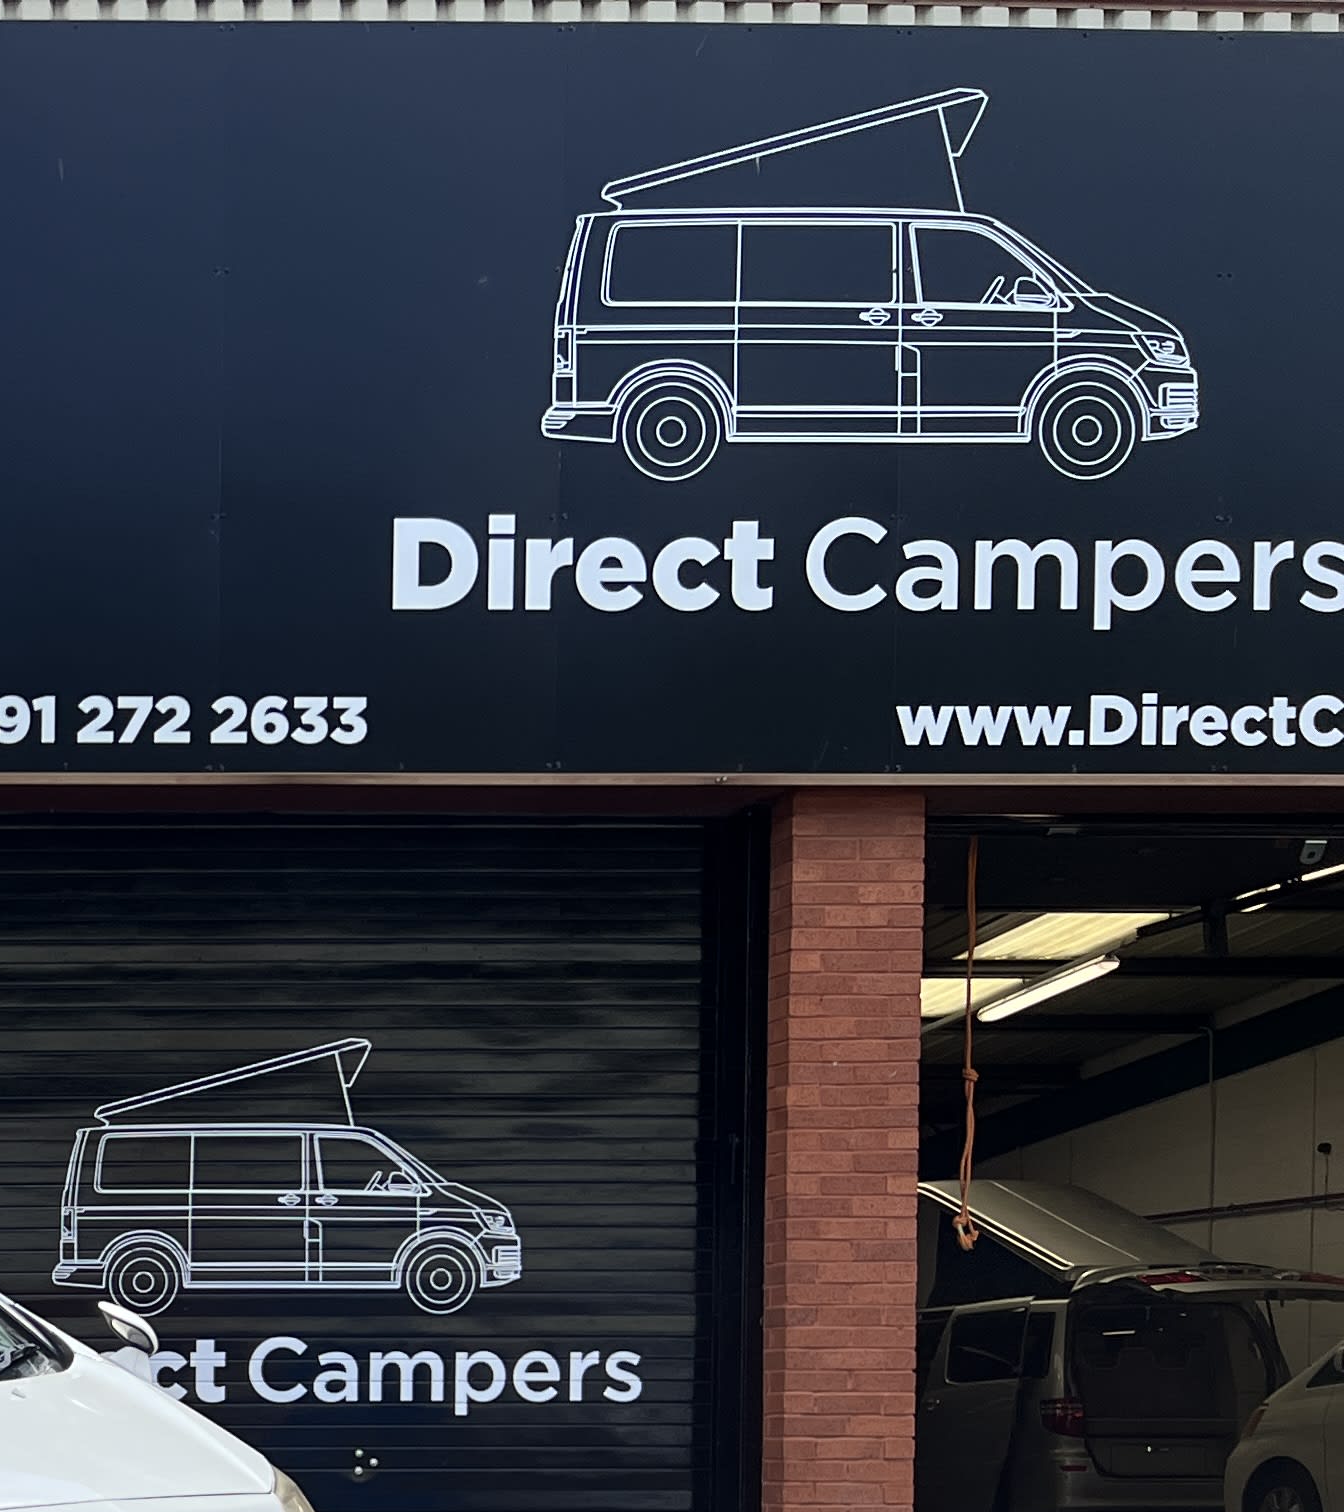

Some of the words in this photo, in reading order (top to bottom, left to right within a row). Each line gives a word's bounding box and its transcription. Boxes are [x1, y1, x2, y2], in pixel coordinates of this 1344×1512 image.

[391, 513, 775, 612] Direct
[805, 516, 1344, 631] Campers
[76, 695, 191, 745] 272
[210, 695, 368, 745] 2633
[895, 692, 1344, 747] www.DirectC
[248, 1336, 643, 1416] Campers
